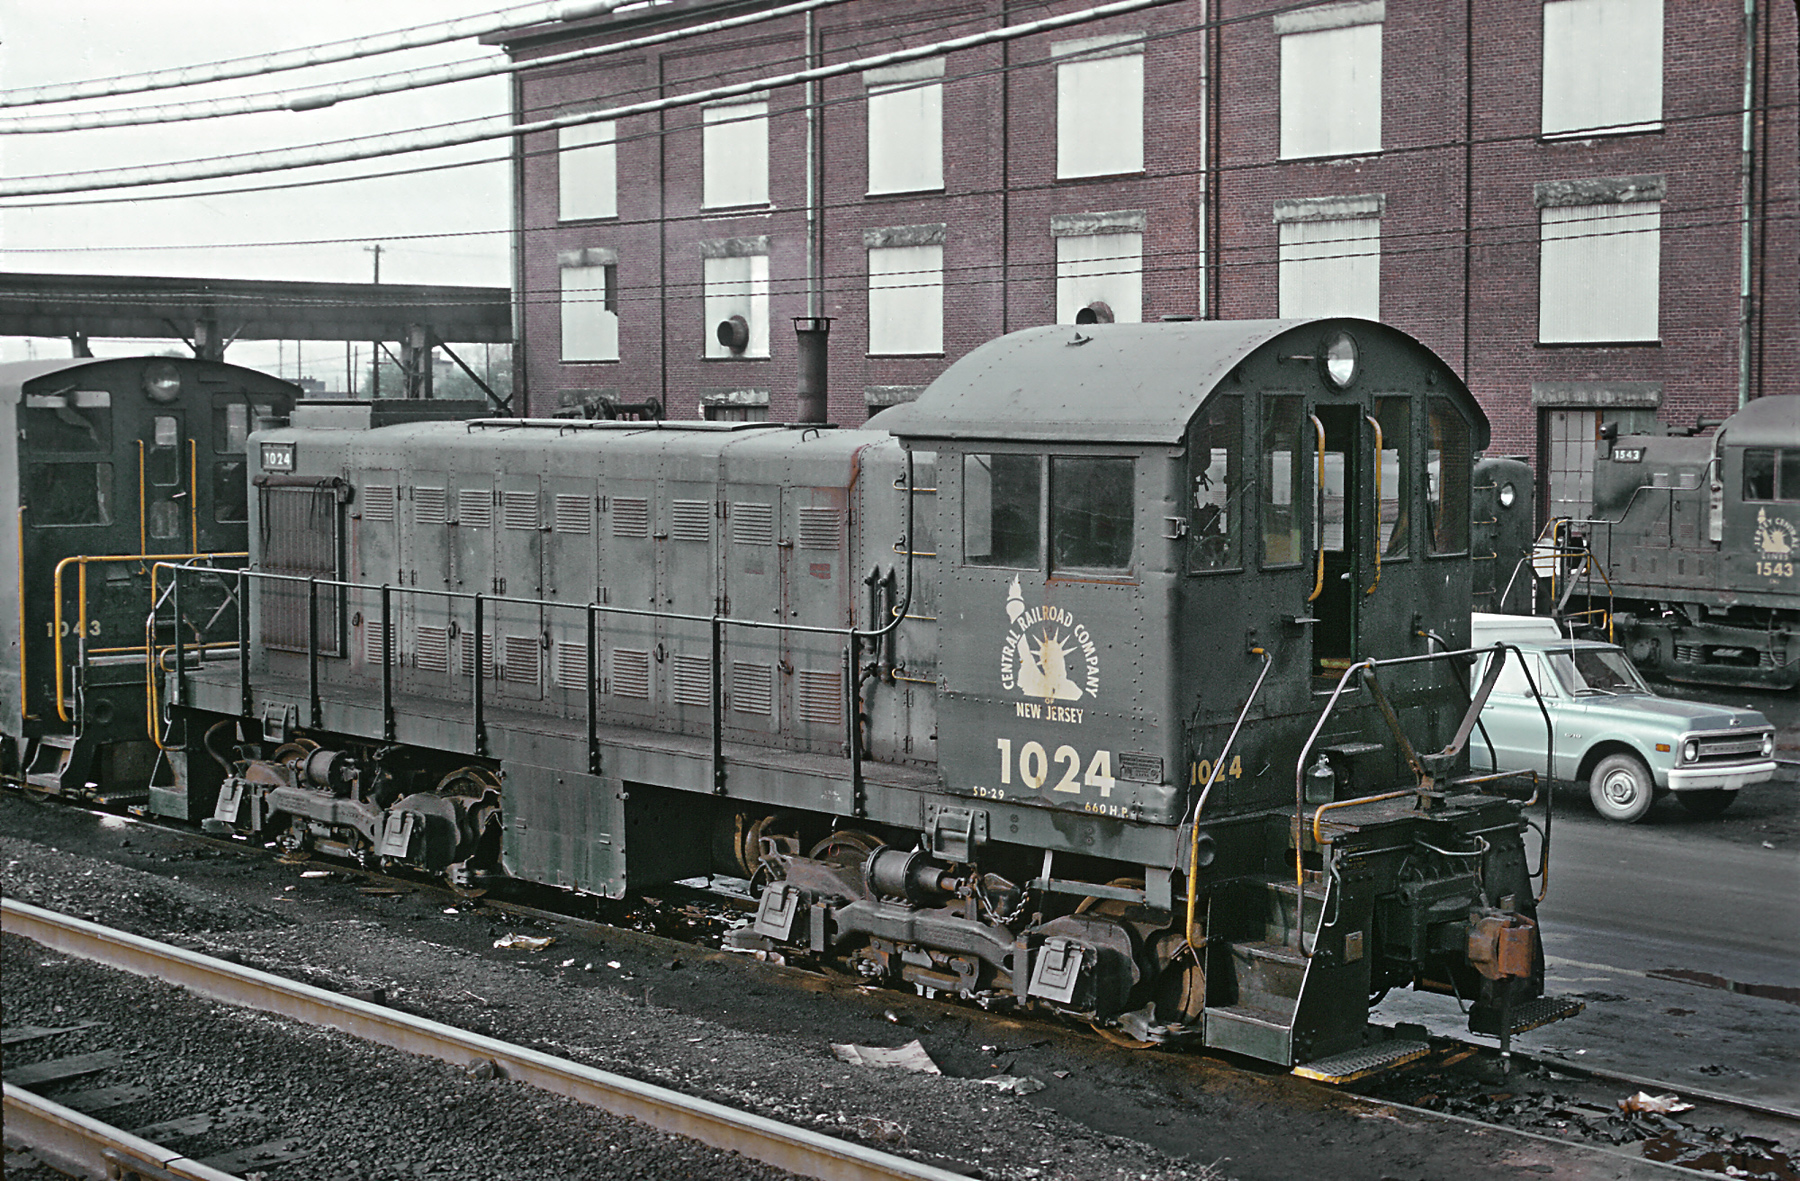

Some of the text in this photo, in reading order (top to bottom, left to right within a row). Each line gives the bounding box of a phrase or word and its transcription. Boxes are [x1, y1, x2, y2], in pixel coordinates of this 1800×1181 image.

[265, 452, 291, 466] 1024
[1615, 450, 1640, 460] 1543
[1756, 562, 1794, 577] 1543
[1001, 604, 1100, 699] CENTRAL RAILROAD COMPANY
[1016, 702, 1084, 724] NEW JERSEY
[997, 738, 1116, 798] 1024
[1084, 801, 1107, 815] 660
